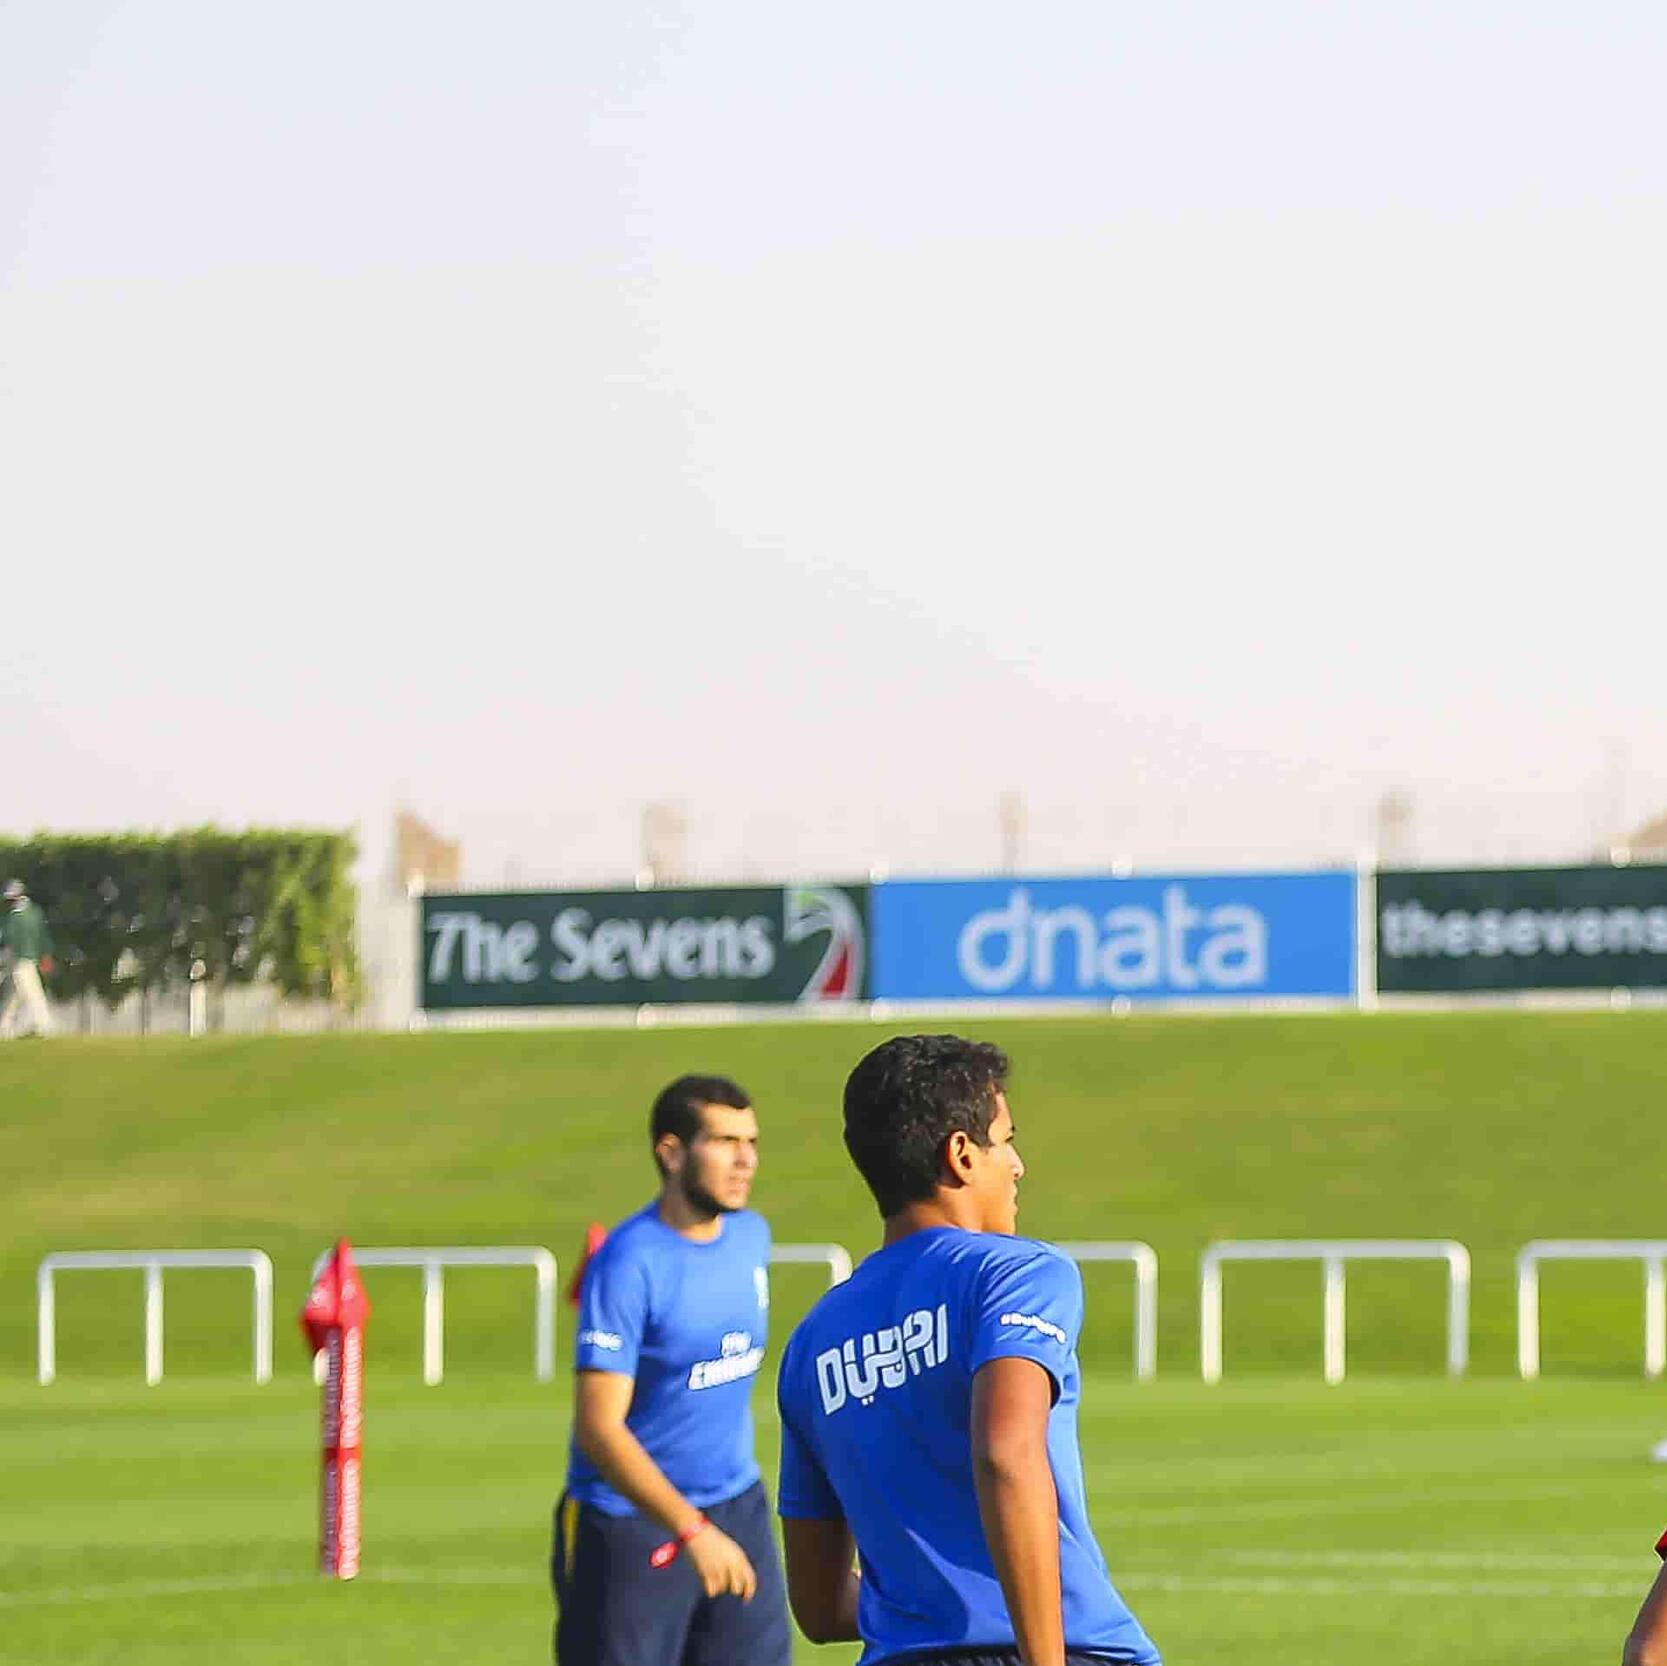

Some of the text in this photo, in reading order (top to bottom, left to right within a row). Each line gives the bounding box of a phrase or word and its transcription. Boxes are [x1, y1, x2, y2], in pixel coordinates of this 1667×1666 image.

[427, 907, 777, 983] The Sevens
[957, 885, 1268, 991] dnata
[815, 1304, 949, 1415] DUBAI
